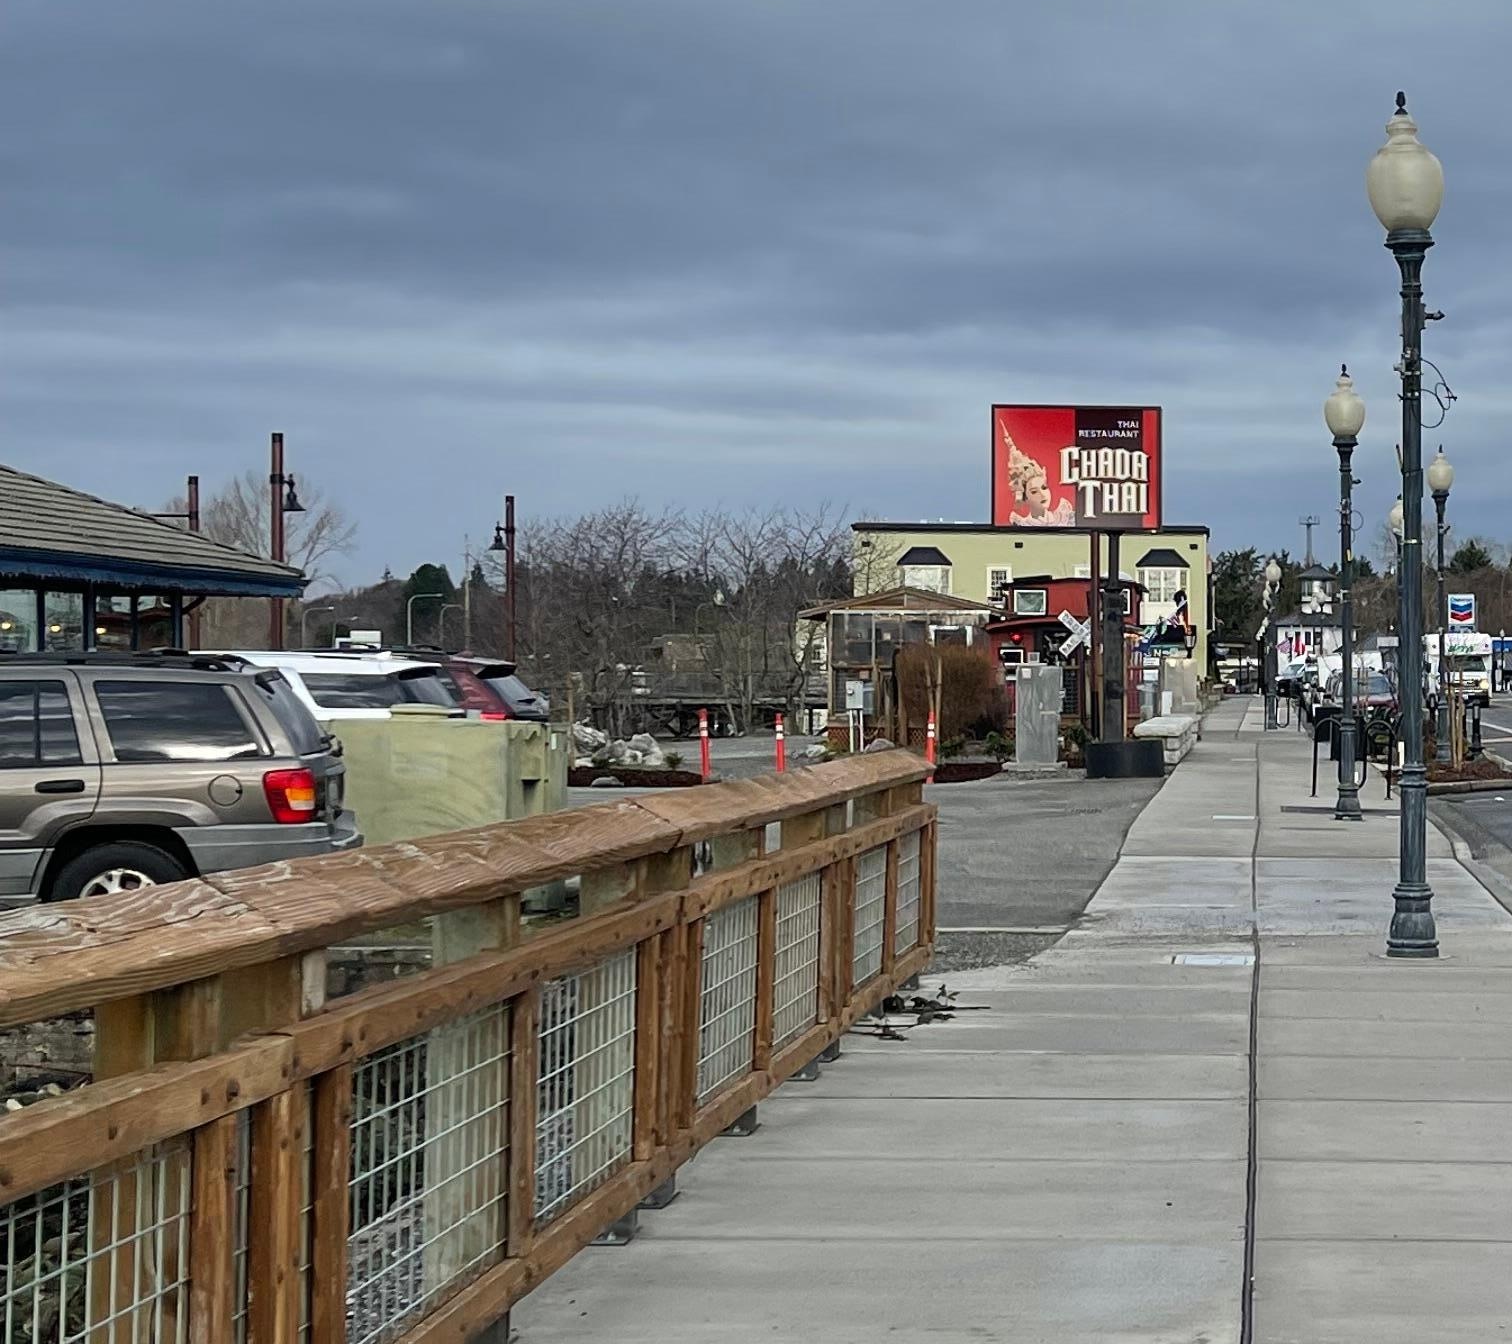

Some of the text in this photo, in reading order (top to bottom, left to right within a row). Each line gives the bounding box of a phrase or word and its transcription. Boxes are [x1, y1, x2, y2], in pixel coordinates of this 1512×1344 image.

[1078, 429, 1139, 438] RESTAURANT
[1117, 420, 1139, 428] THAI
[1059, 446, 1149, 484] CHADA
[1078, 480, 1149, 518] THAI
